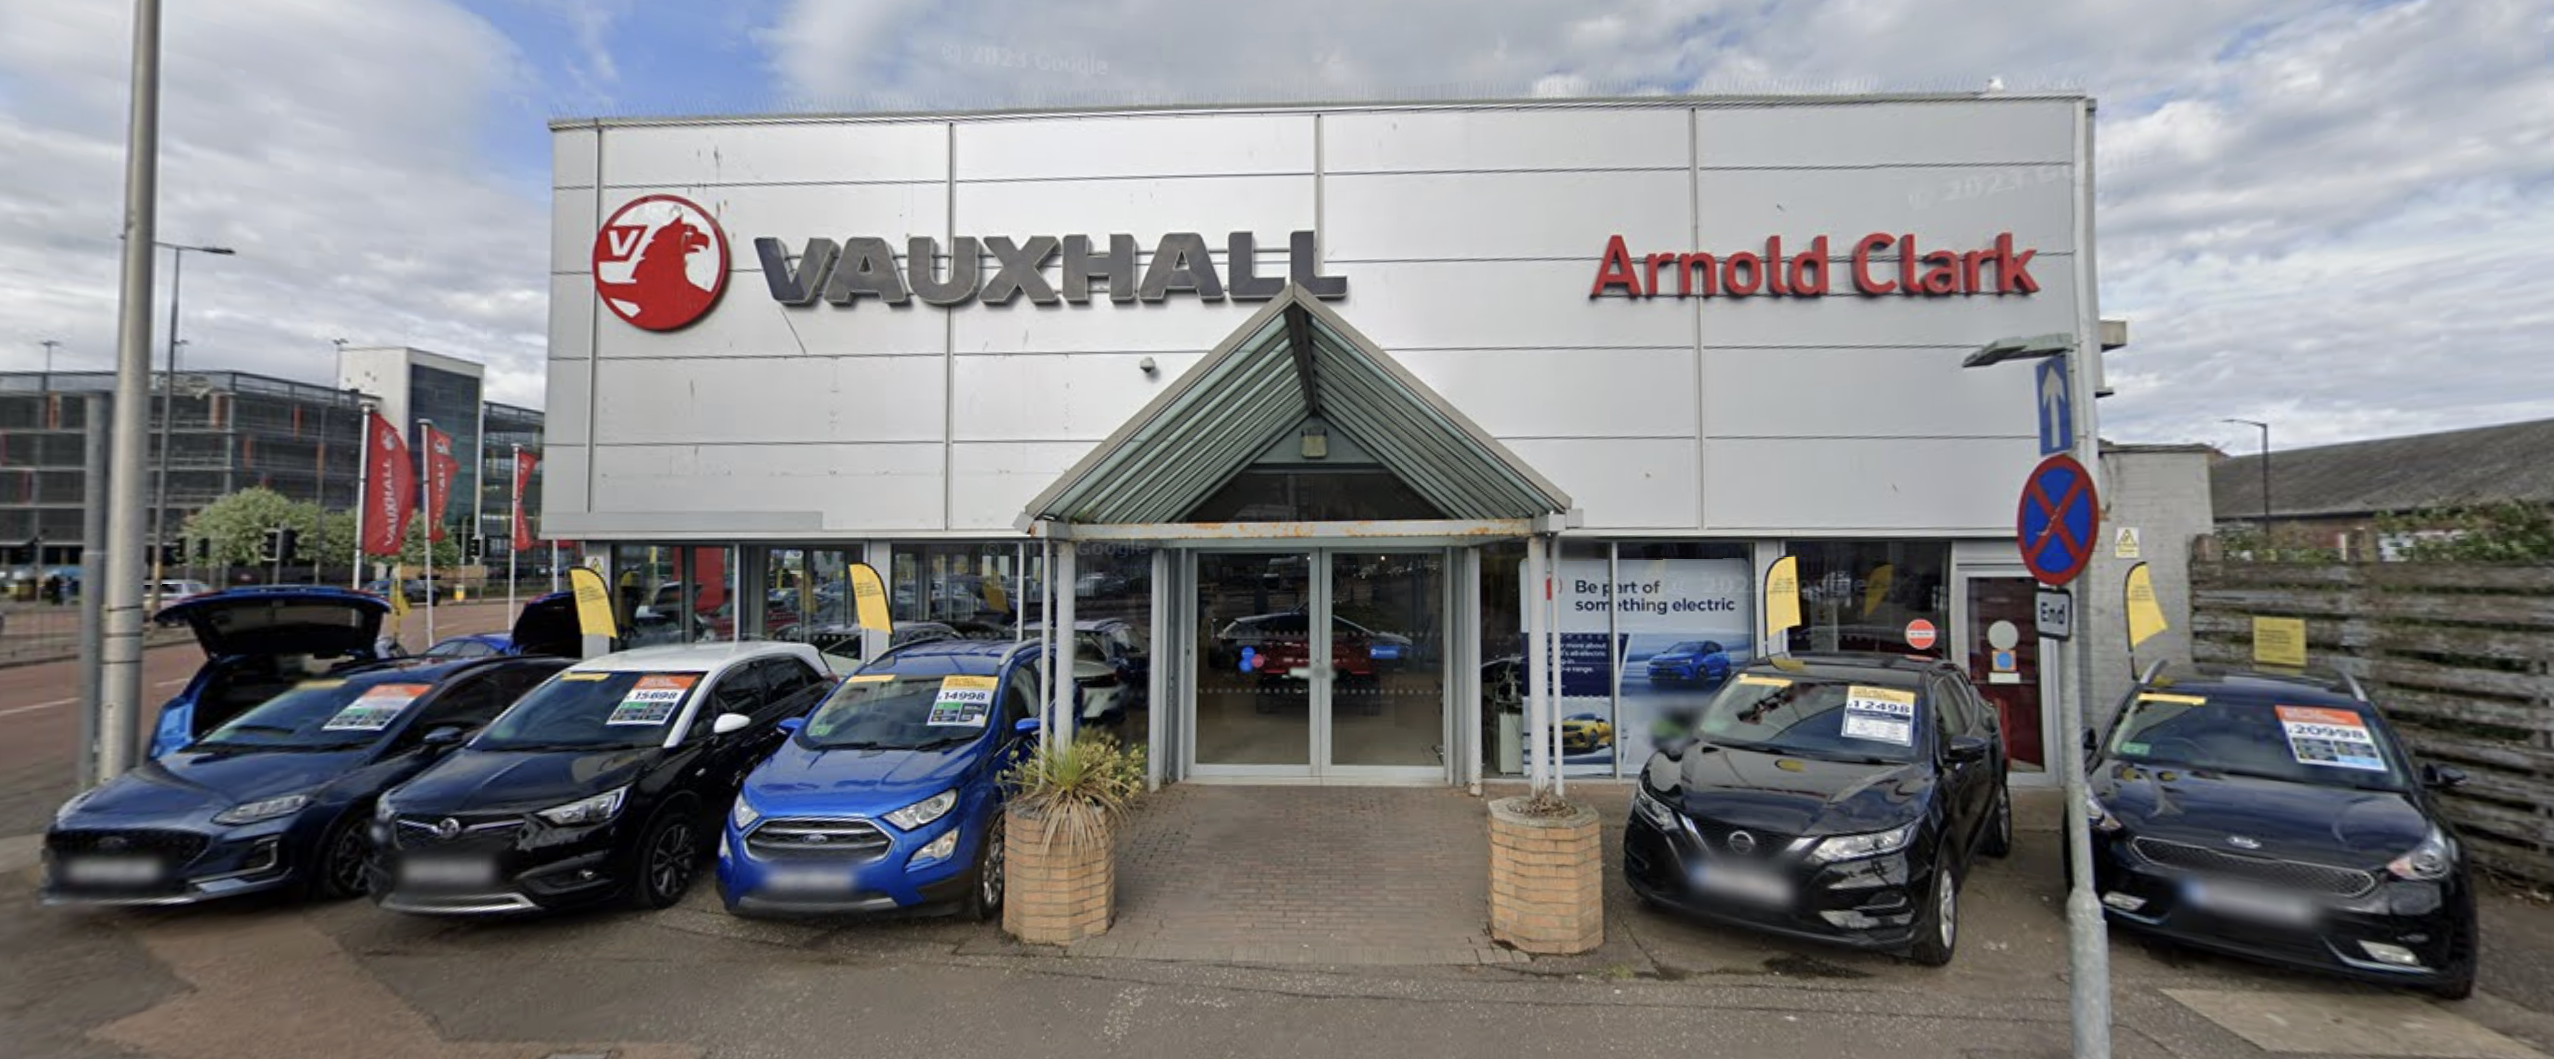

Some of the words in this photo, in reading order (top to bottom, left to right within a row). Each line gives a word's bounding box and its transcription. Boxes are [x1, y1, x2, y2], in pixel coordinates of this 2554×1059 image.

[608, 229, 641, 257] V
[754, 231, 1348, 304] VAUXHALL
[1590, 234, 1828, 298] Arnold
[1852, 232, 2040, 297] Clark
[379, 458, 400, 547] VAUXHALL
[1575, 580, 1597, 594] Be
[1602, 581, 1638, 597] part
[1642, 580, 1661, 594] of
[1672, 597, 1736, 612] electric
[2041, 601, 2065, 625] End
